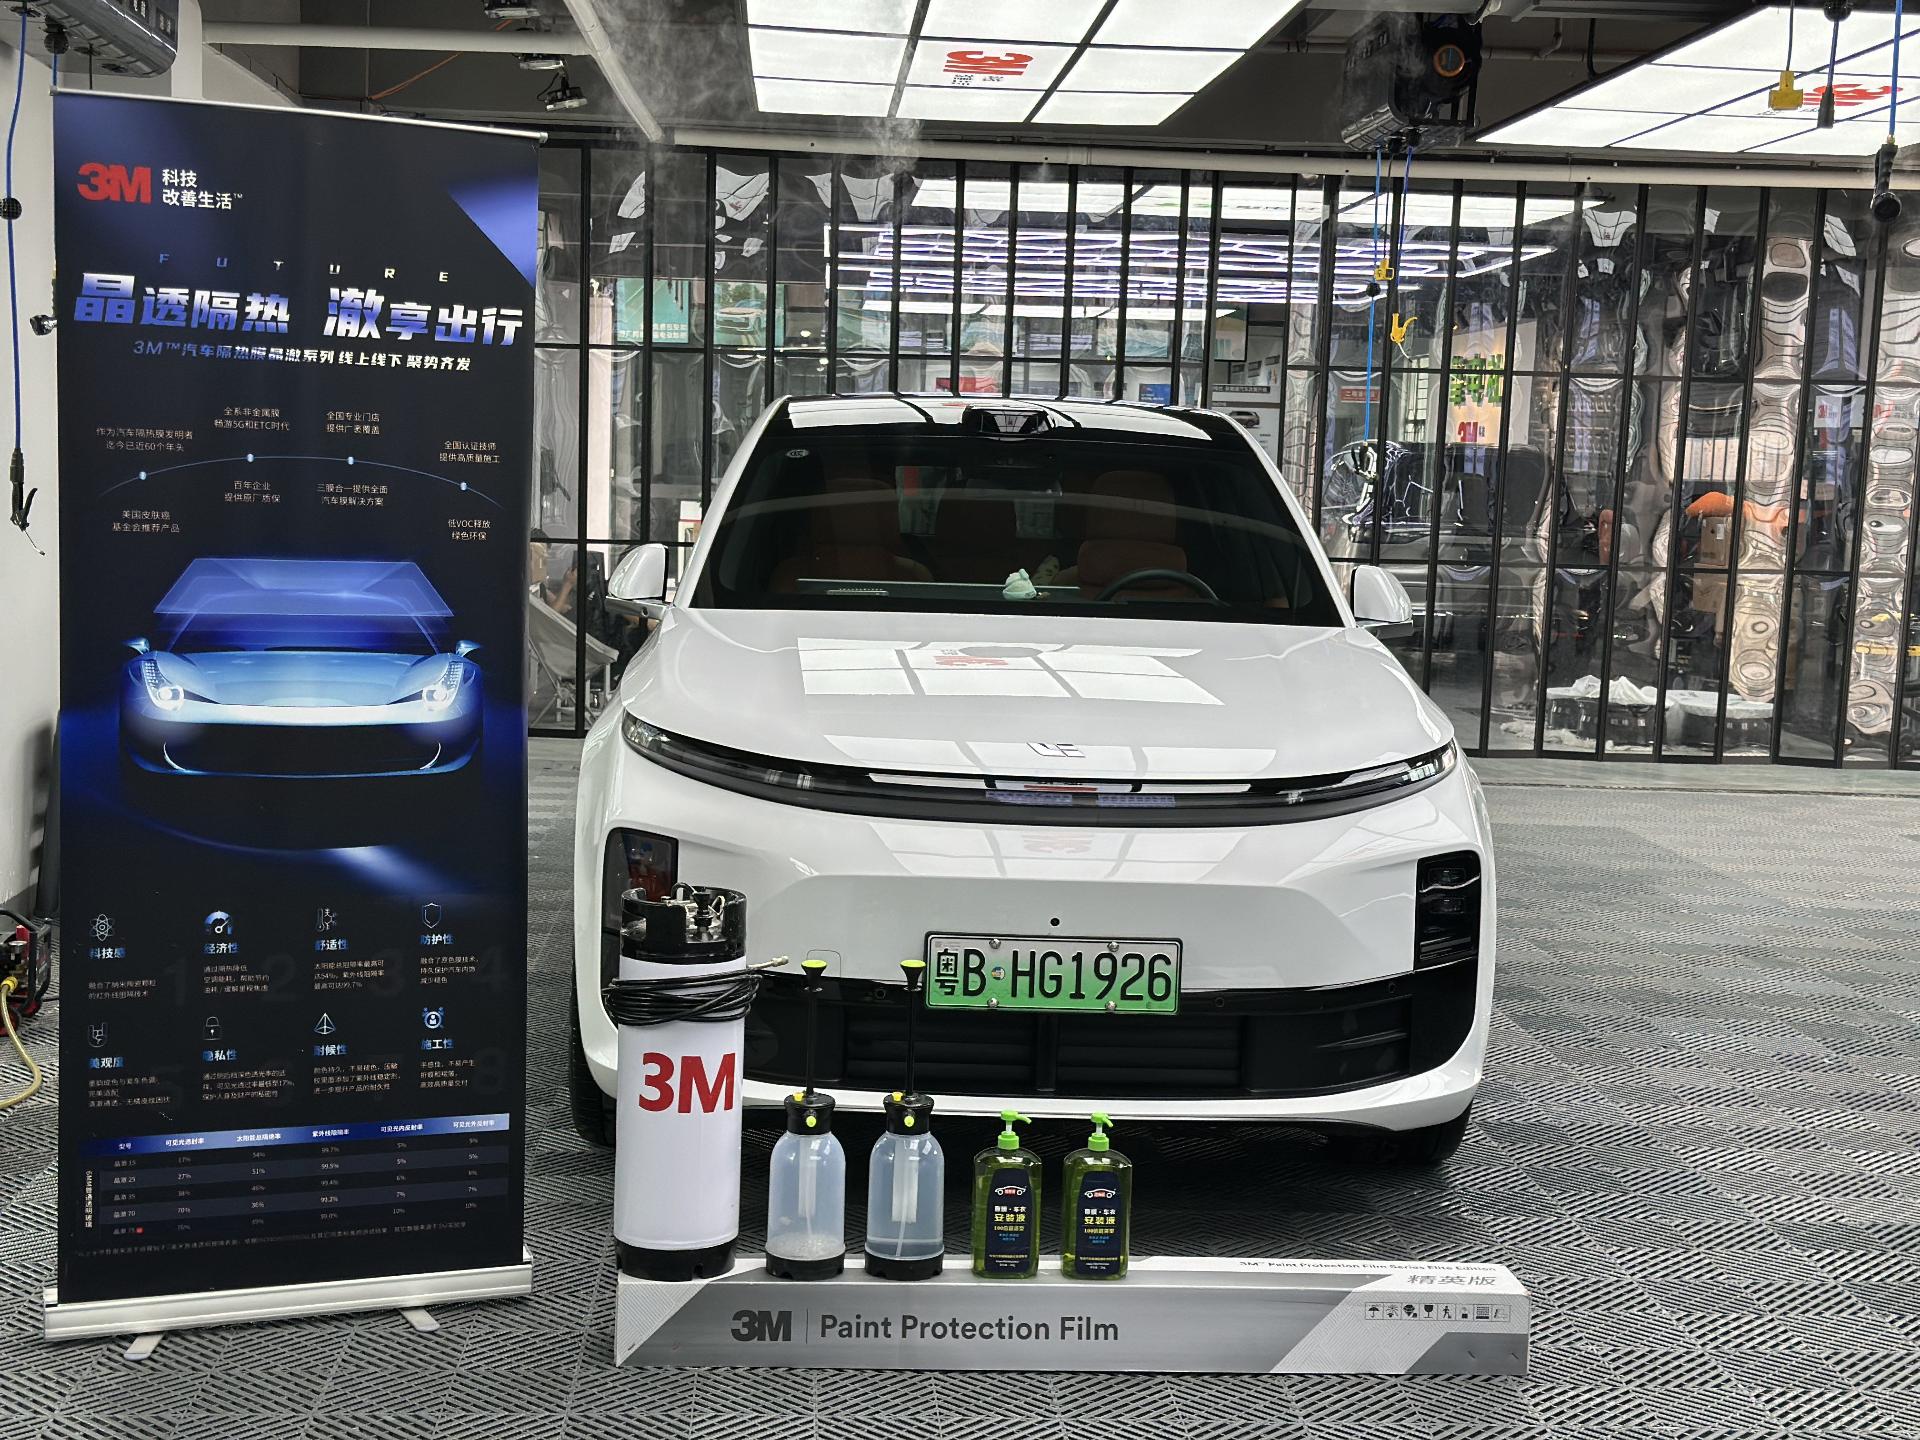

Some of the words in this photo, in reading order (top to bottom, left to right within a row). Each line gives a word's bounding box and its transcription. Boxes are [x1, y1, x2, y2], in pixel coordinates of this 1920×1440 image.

[942, 51, 1034, 76] 3M
[76, 162, 152, 204] 3M
[162, 168, 198, 188] 科技
[73, 272, 291, 334] 晶透隔热
[322, 286, 523, 347] 澈享出行
[338, 350, 402, 369] 线上线下
[406, 354, 470, 371] 聚势齐发
[224, 406, 280, 418] 全系非金属膜
[325, 410, 381, 423] 全国专业门店
[96, 427, 194, 442] 作为汽车隔热膜发明者
[444, 440, 497, 453] 全国认证技师
[439, 451, 501, 464] 提供高质量施工
[233, 480, 271, 491] 百年企业
[315, 483, 389, 495] 三膜合一提供全面
[320, 495, 385, 508] 汽车膜解决方案
[111, 521, 181, 534] 基金会推荐产品
[447, 518, 491, 530] 低VOC释放
[451, 530, 488, 542] 绿色环保
[315, 939, 349, 951] 舒适性
[420, 933, 455, 946] 防护性
[88, 947, 126, 960] 科技感
[203, 943, 240, 955] 经济性
[313, 1044, 349, 1057] 耐候性
[420, 1038, 455, 1050] 施工性
[638, 1052, 736, 1114] 3M
[1407, 1274, 1497, 1286] 精英版
[730, 1309, 792, 1342] 3M
[820, 1313, 892, 1338] Paint
[901, 1314, 1050, 1340] Protection
[1060, 1315, 1119, 1341] Film
